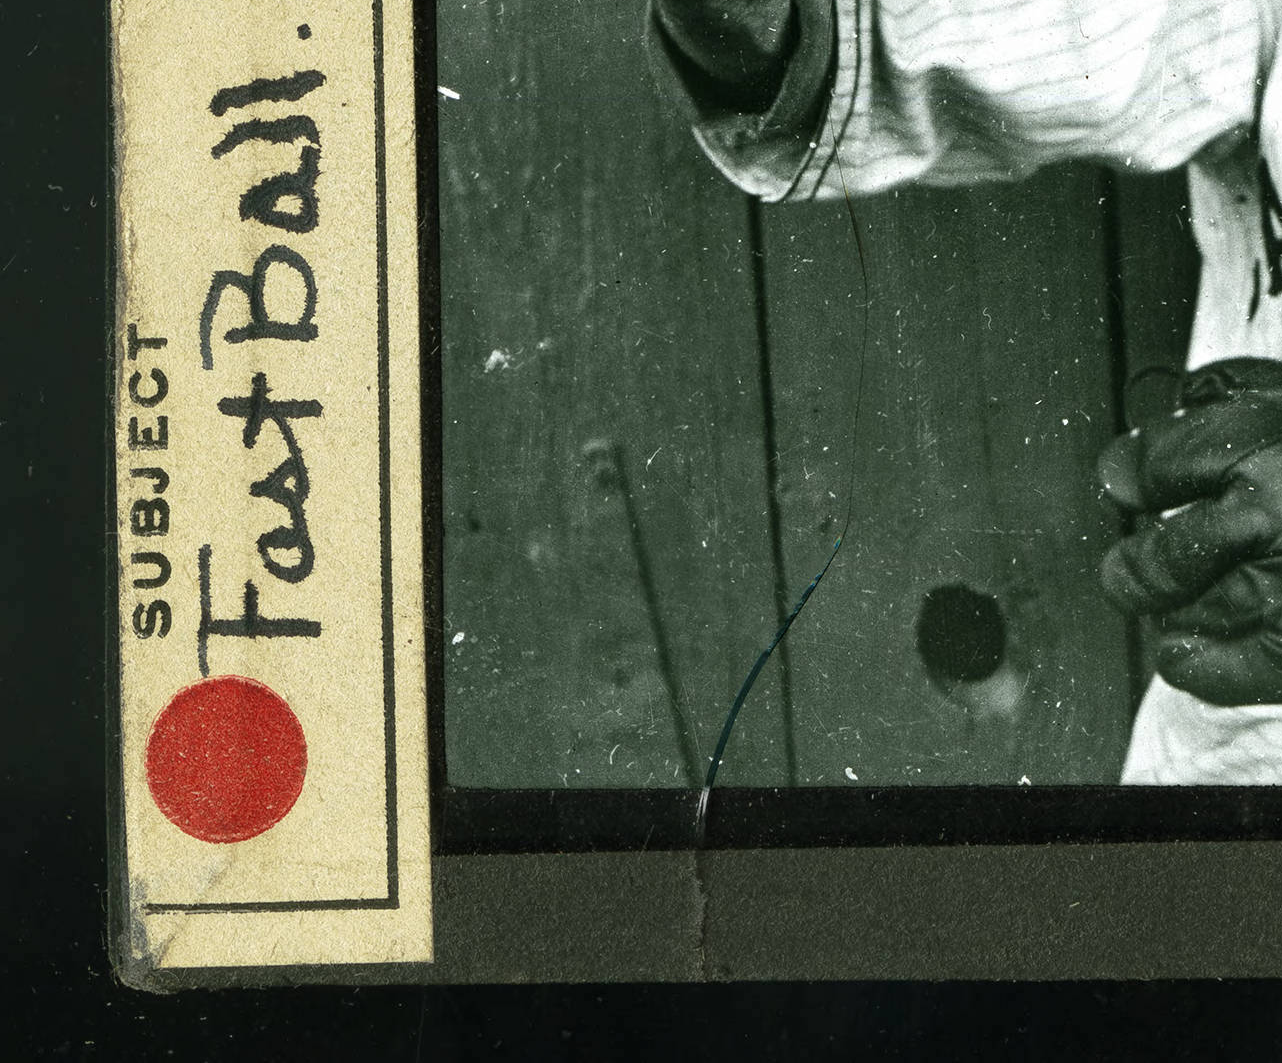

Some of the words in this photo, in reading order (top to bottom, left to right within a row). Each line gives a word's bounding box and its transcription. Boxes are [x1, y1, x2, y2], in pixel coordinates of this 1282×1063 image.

[199, 23, 327, 370] Ball.
[127, 323, 172, 638] SUBJECT
[196, 371, 324, 679] Fast
